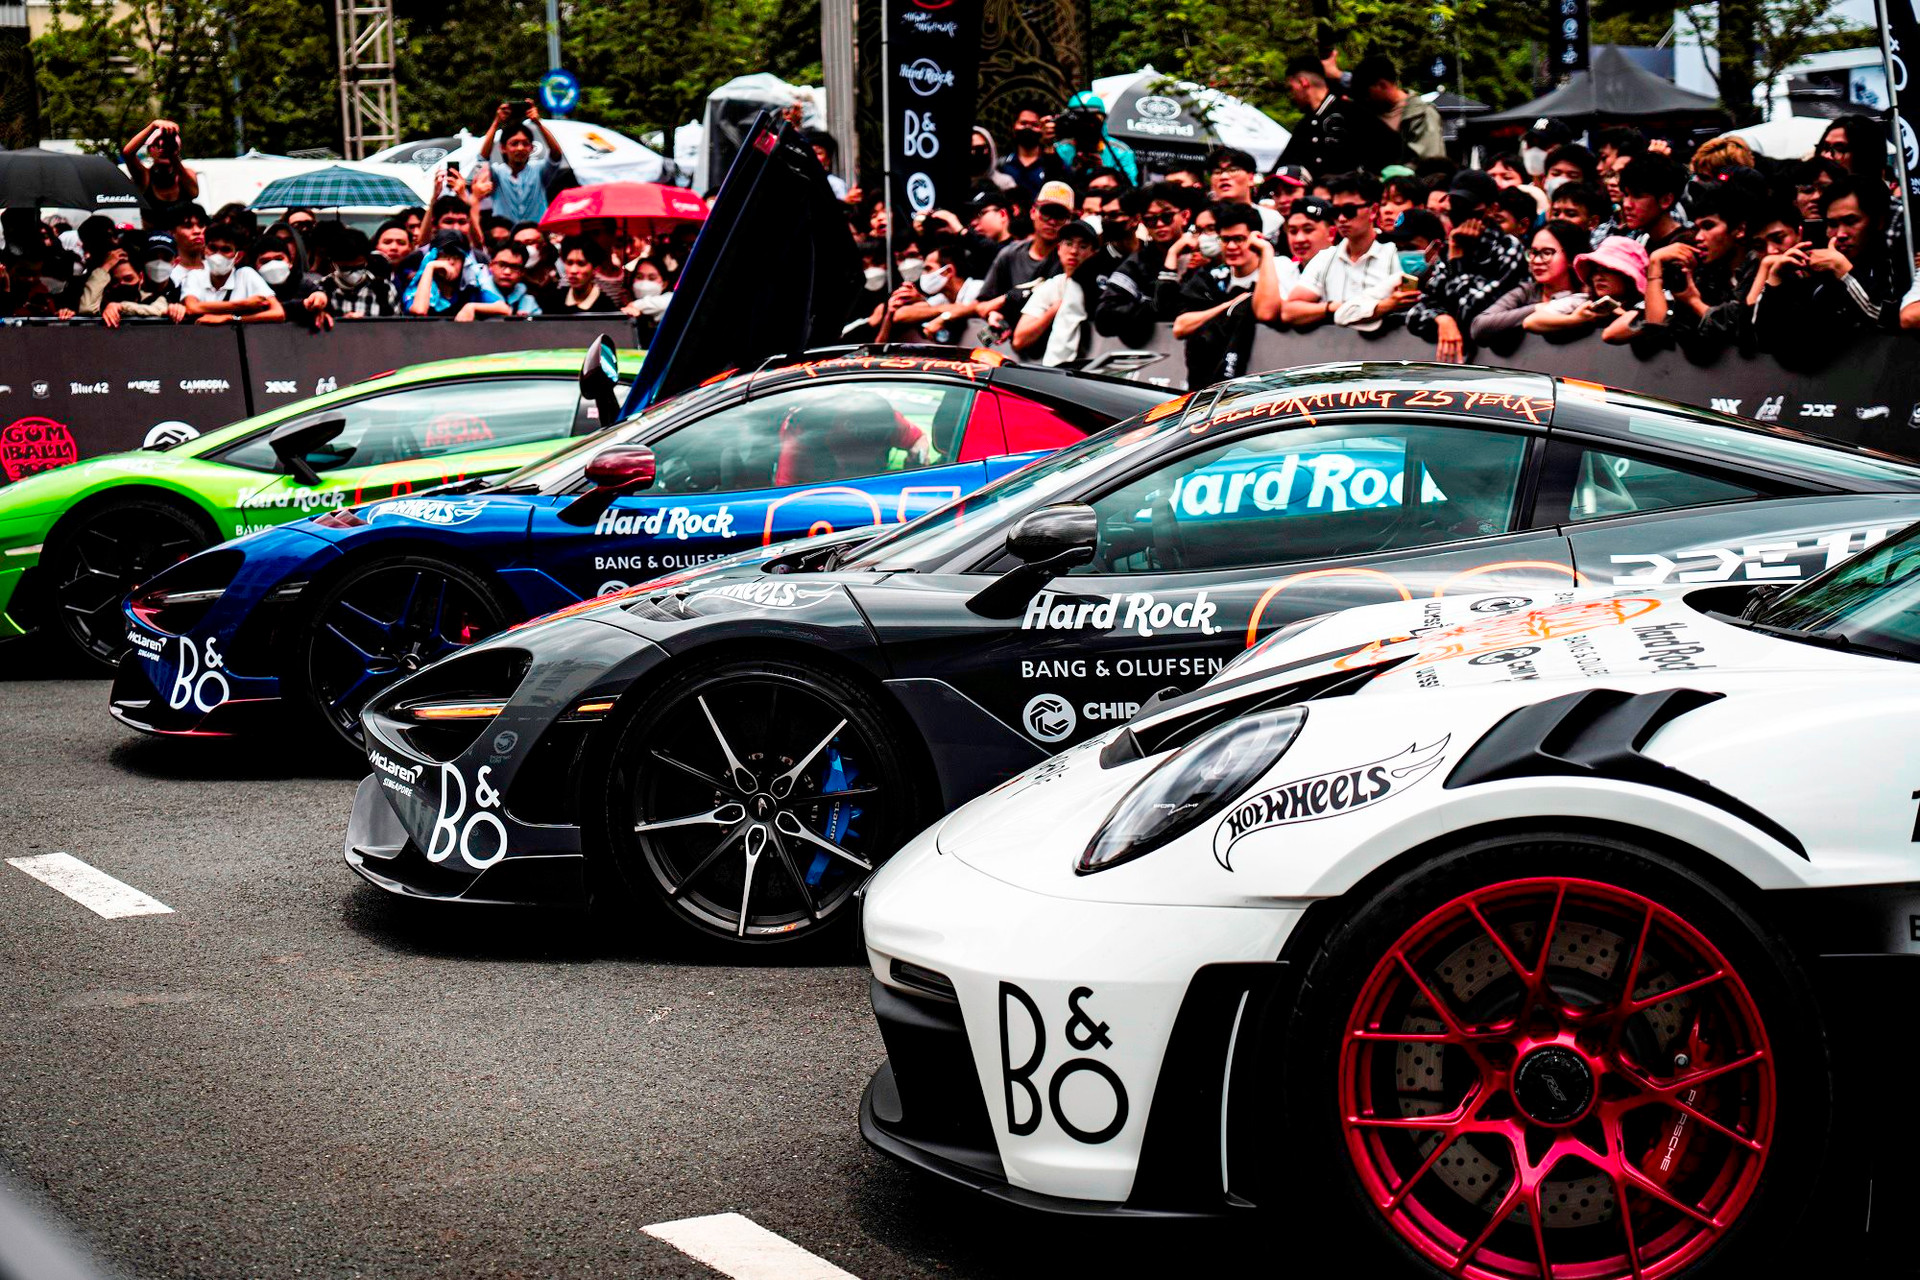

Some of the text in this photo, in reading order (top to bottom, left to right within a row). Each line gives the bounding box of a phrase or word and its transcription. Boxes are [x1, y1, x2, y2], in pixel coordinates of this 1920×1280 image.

[594, 507, 667, 535] Hard
[595, 556, 642, 570] BANG
[648, 555, 659, 569] &
[1021, 592, 1122, 630] Hard
[127, 630, 162, 652] McLaren
[1021, 659, 1087, 678] BANG
[1096, 659, 1110, 677] &
[368, 750, 416, 784] McLaren
[382, 777, 413, 797] SINGAPORE
